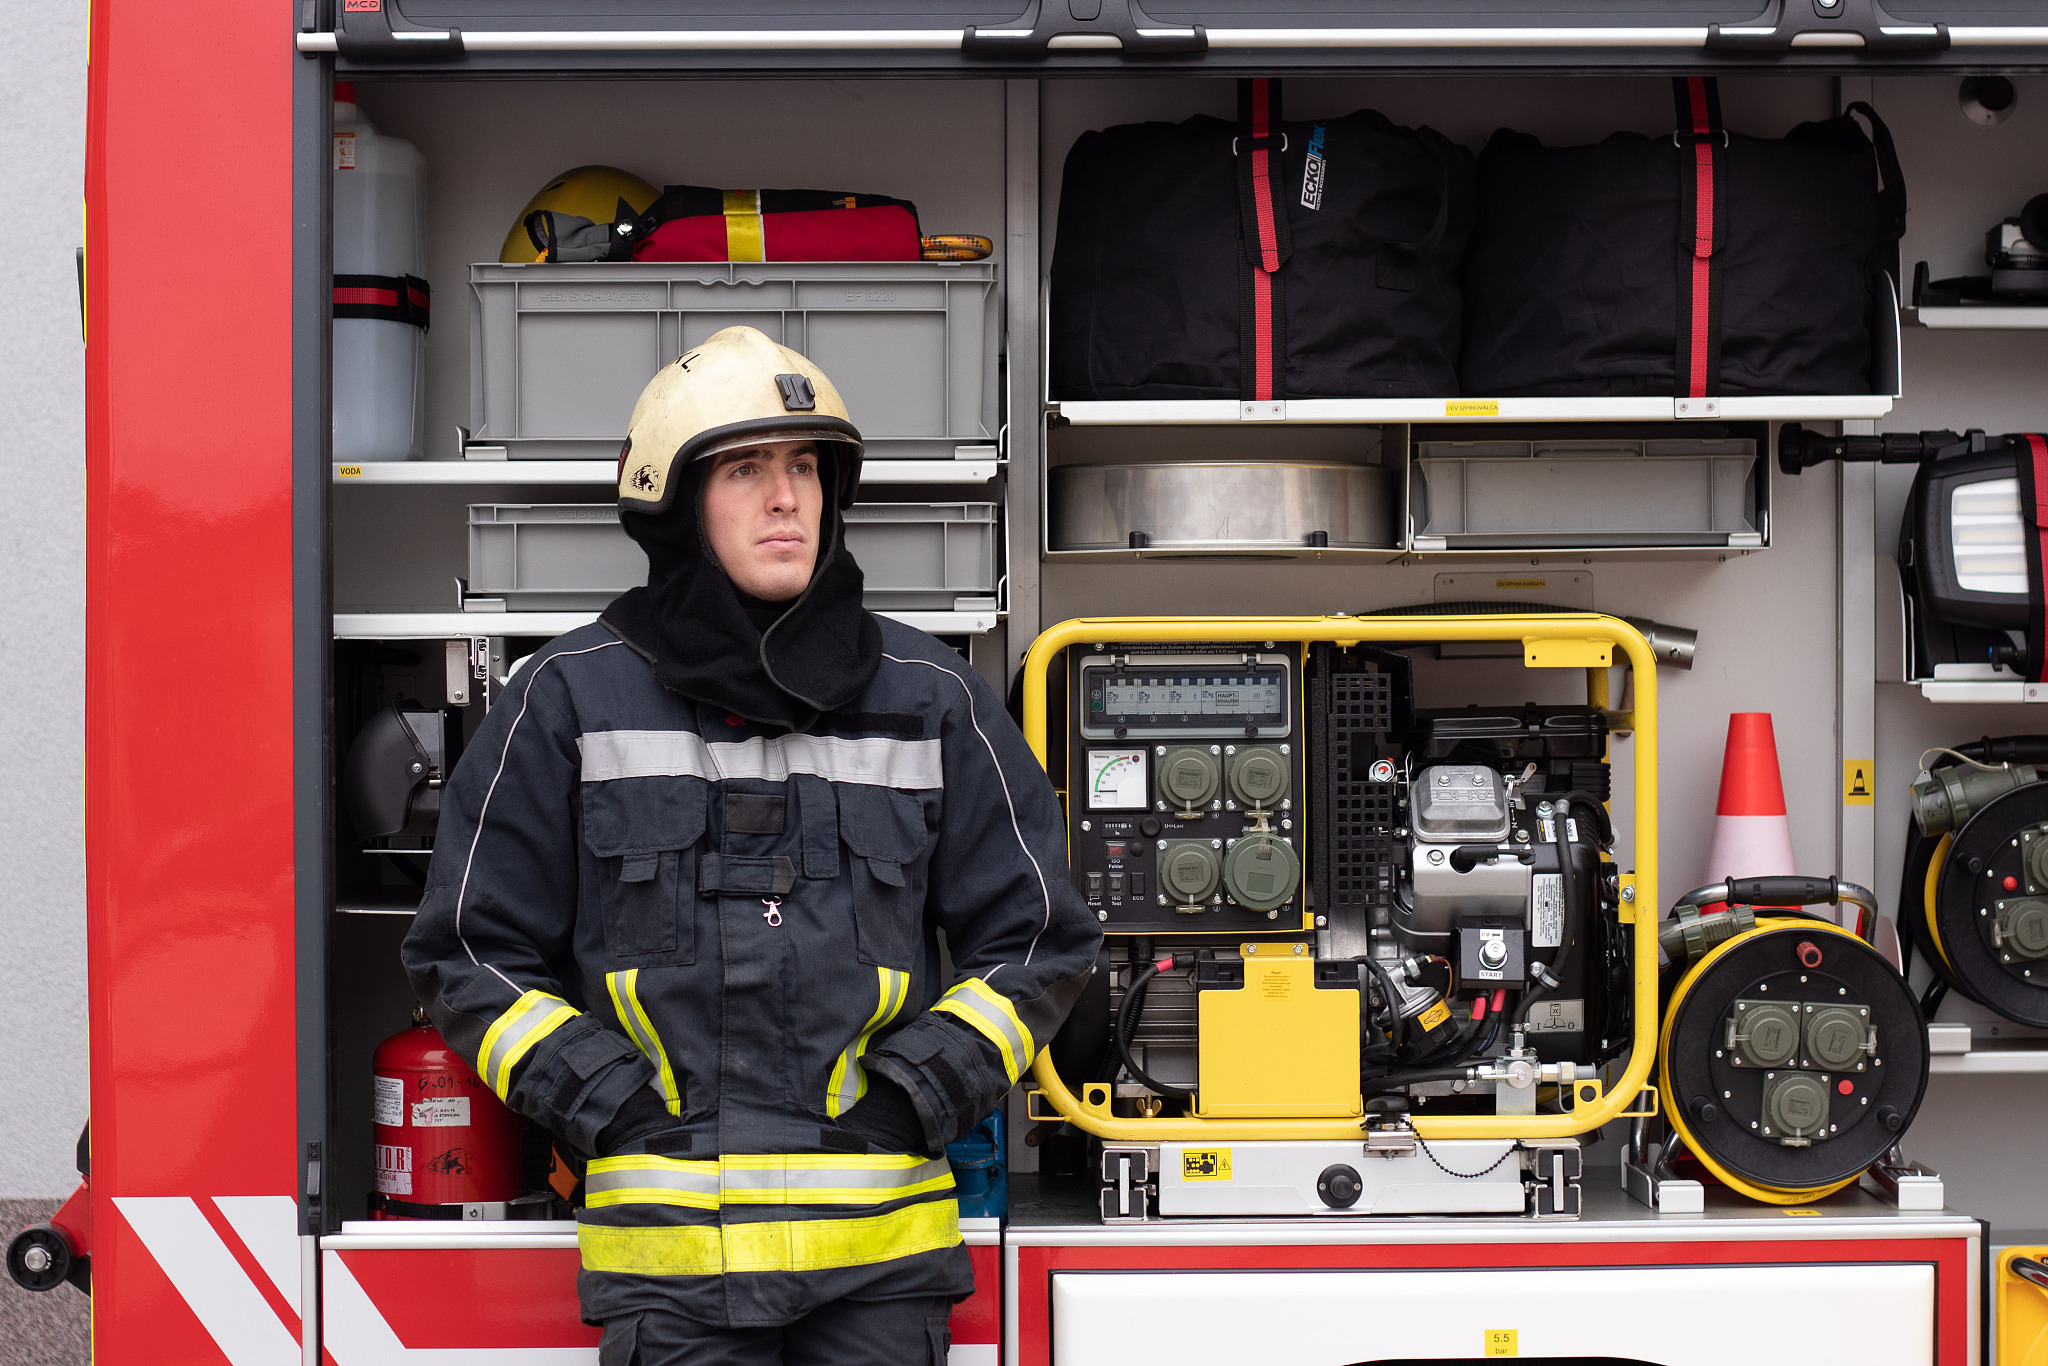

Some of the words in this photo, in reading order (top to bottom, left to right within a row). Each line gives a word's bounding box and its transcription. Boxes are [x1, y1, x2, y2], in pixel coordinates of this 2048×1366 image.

[1308, 125, 1325, 158] Flex
[1303, 160, 1320, 206] ECKO
[845, 291, 862, 301] EF
[866, 291, 896, 301] 6220
[340, 467, 361, 475] VODA
[1493, 1333, 1510, 1343] 5.5
